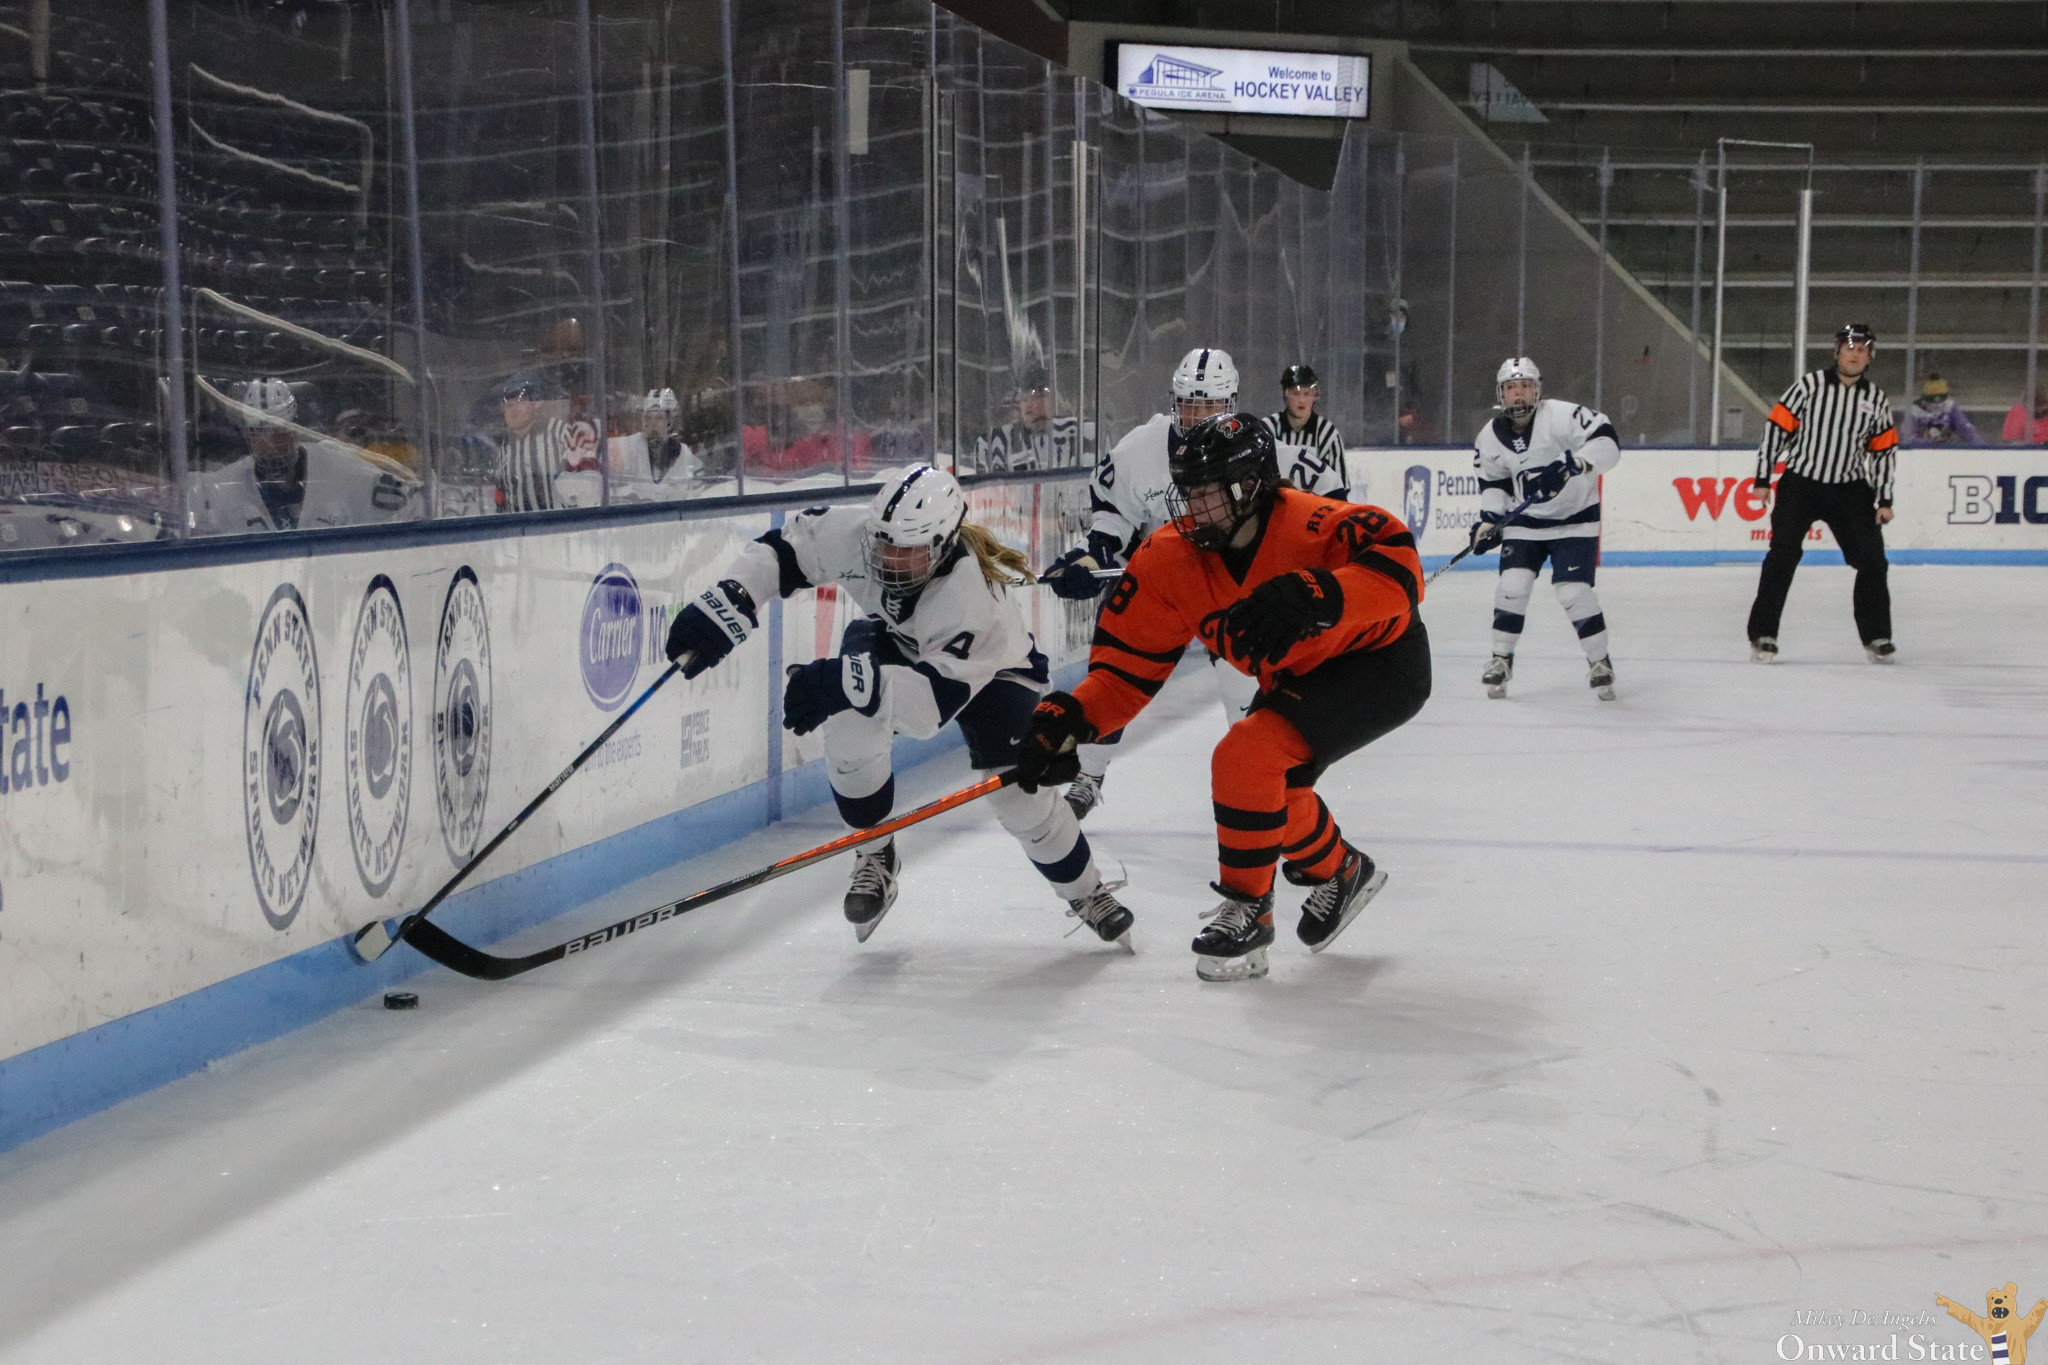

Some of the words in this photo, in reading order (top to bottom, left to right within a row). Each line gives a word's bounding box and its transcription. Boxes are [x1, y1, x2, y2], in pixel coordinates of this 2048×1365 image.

[1138, 88, 1175, 98] PEGULA
[1177, 90, 1193, 99] ICE
[1195, 91, 1226, 100] ARENA
[1234, 81, 1300, 100] HOCKEY
[1304, 83, 1364, 102] VALLEY
[1268, 66, 1318, 81] Welcome
[1320, 68, 1332, 81] to
[1437, 470, 1477, 496] Penn
[1335, 510, 1390, 552] 28
[353, 600, 377, 692] PENN
[440, 594, 461, 676] PENN
[589, 603, 636, 665] Carrier
[942, 630, 976, 660] 4
[253, 611, 281, 710] PENN
[285, 608, 315, 701] STATE
[563, 905, 677, 959] BAUER
